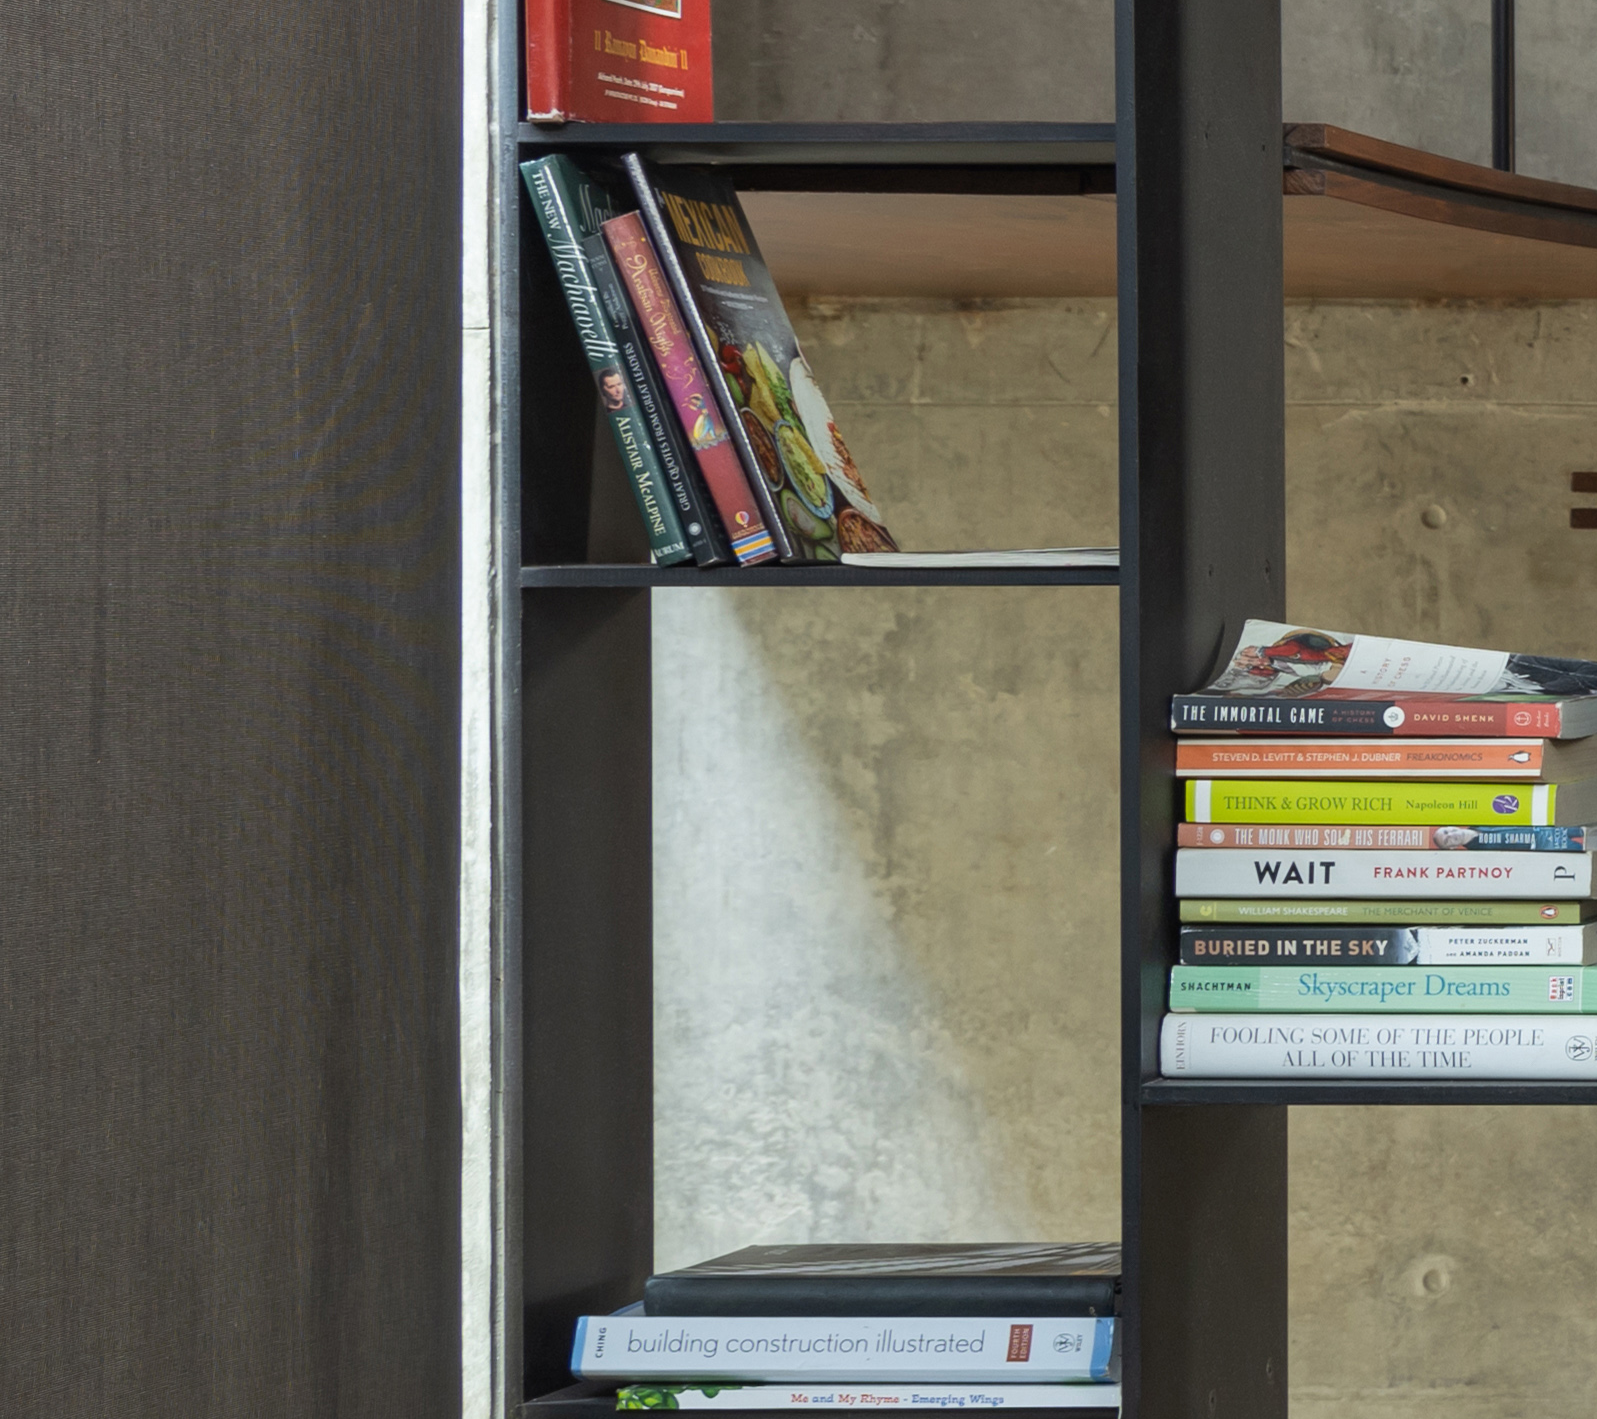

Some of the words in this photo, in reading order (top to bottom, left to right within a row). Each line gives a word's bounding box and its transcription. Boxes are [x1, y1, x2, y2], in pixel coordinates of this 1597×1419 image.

[532, 172, 548, 199] THE
[540, 201, 562, 231] NEW
[548, 232, 619, 360] Machiavelli
[616, 416, 644, 470] ALISTAIR
[636, 471, 666, 535] McALPINE
[1183, 706, 1206, 720] THE
[1214, 706, 1283, 722] IMMORTAL
[1290, 708, 1325, 724] GAME
[1413, 713, 1449, 722] DAVID
[1455, 714, 1495, 723] SHENK
[1224, 796, 1277, 811] THINK
[1281, 796, 1292, 811] &
[1296, 797, 1347, 811] GROW
[1352, 797, 1392, 811] RICH
[1255, 862, 1335, 884] WAIT
[1374, 867, 1429, 878] FRANK
[1437, 867, 1513, 879] PARTNOY
[1298, 973, 1417, 1001] Skyscraper
[1424, 976, 1510, 996] Dreams
[595, 1327, 607, 1358] CHING
[628, 1329, 719, 1356] building
[726, 1331, 869, 1353] construction
[875, 1330, 984, 1354] illustrated
[791, 1394, 809, 1404] Me
[813, 1393, 834, 1404] and
[838, 1393, 856, 1406] My
[861, 1393, 900, 1406] Rhyme
[912, 1393, 965, 1407] Emerging
[969, 1393, 1004, 1407] Wings
